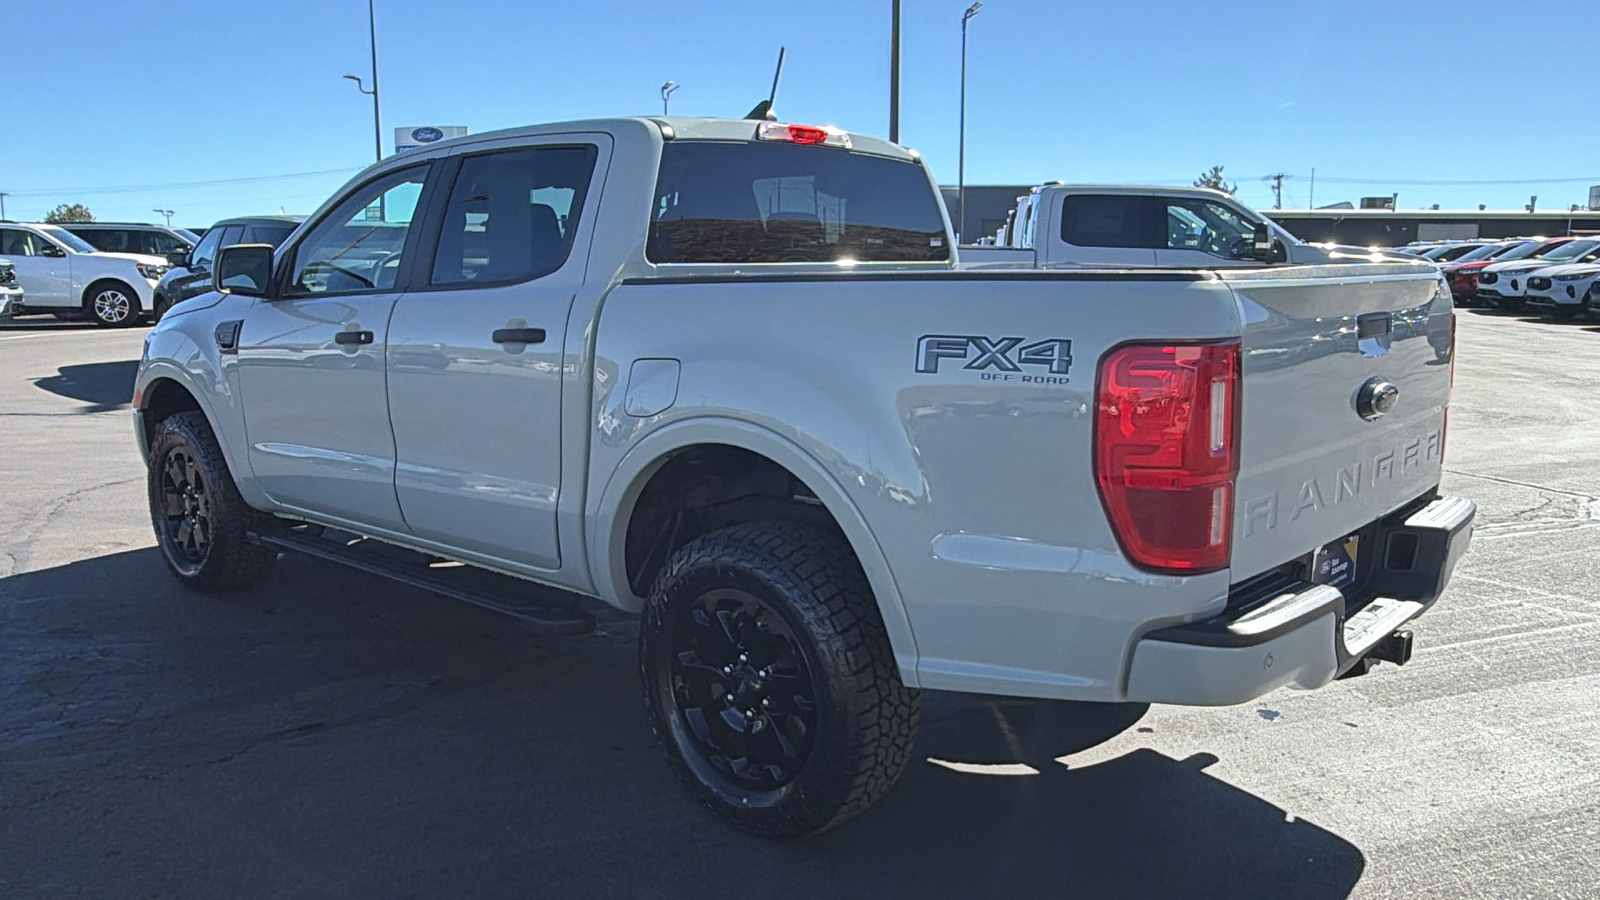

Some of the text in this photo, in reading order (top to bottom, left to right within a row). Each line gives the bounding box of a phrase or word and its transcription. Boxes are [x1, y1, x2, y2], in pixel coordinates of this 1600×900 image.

[417, 130, 436, 140] Ford
[914, 334, 1073, 375] FX4
[980, 372, 1070, 385] OFF ROAD
[1242, 428, 1441, 539] RANGER
